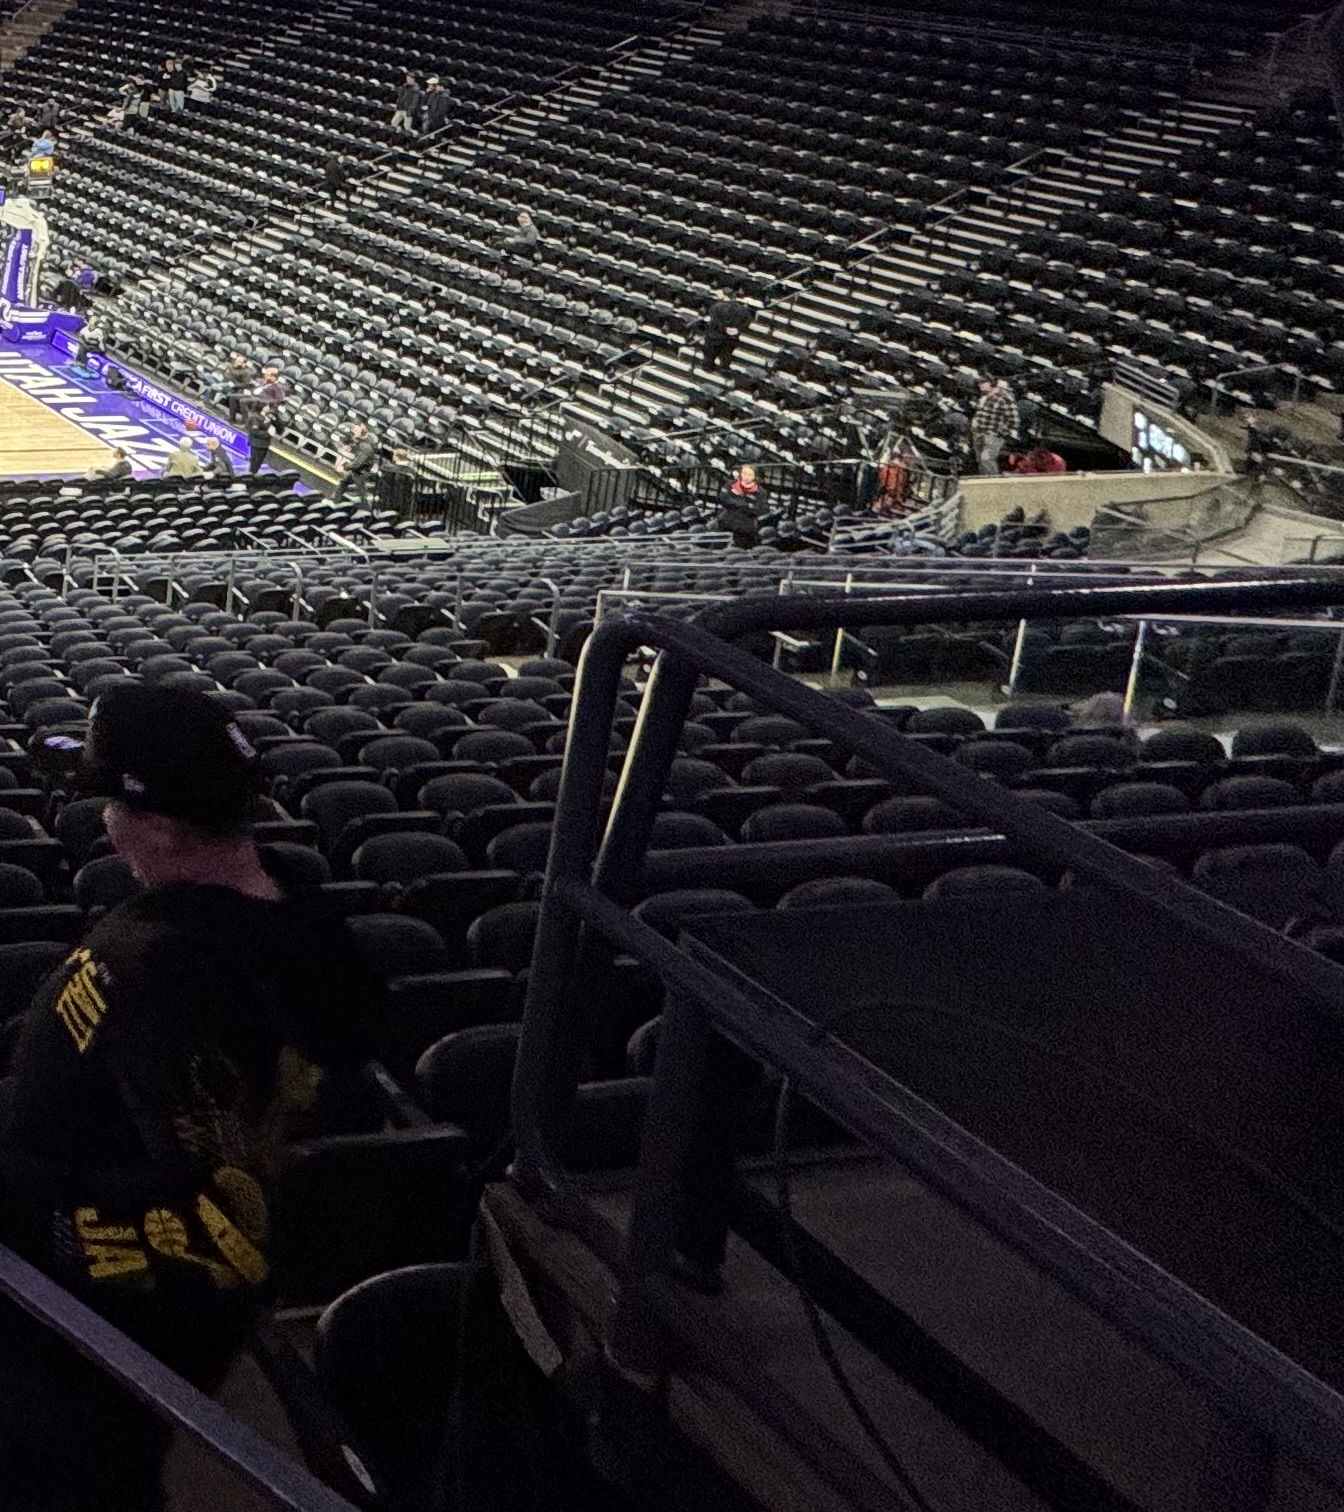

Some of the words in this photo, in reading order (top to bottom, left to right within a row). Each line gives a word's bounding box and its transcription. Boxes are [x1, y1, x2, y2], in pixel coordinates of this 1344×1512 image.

[140, 384, 172, 408] FIRST
[170, 400, 207, 426] CREDIT
[201, 415, 237, 444] UNION
